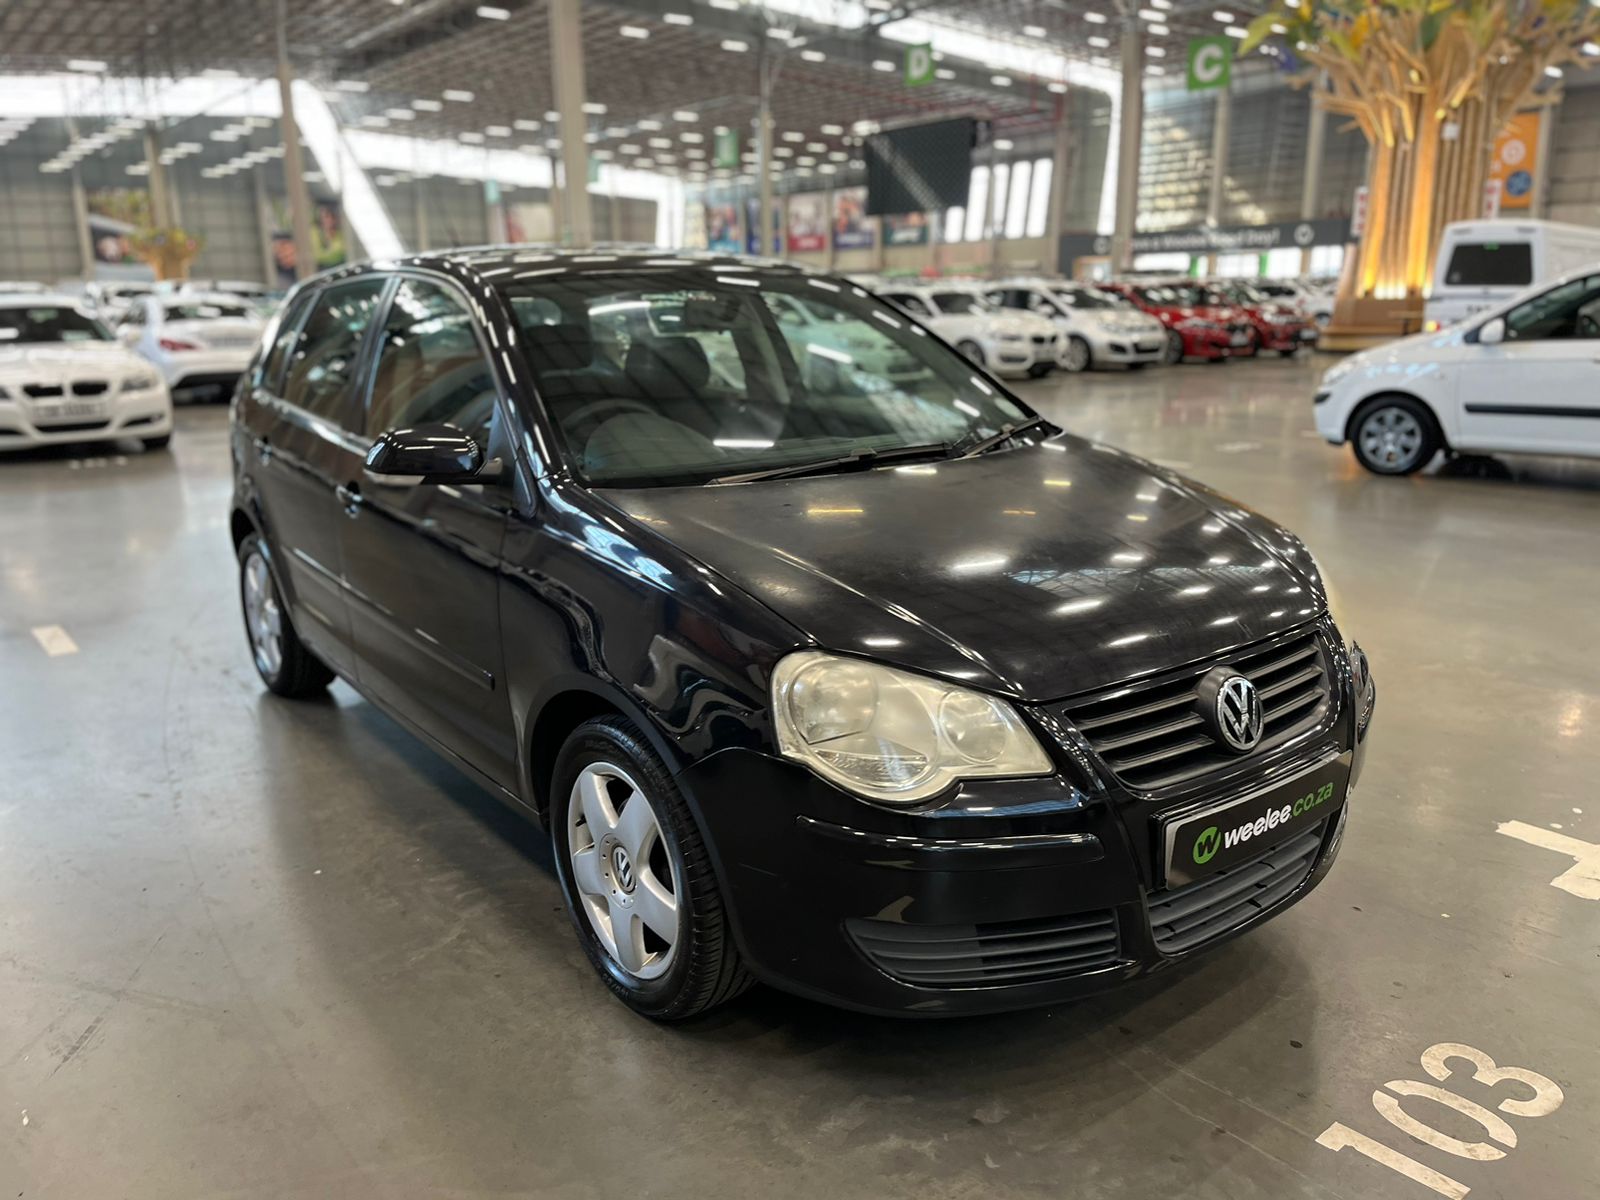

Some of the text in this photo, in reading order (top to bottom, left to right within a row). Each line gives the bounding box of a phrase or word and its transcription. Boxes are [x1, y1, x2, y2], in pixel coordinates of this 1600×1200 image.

[909, 48, 930, 79] D
[1194, 43, 1224, 82] C
[1225, 782, 1333, 849] weelee.co.za
[1315, 1042, 1564, 1200] 103
